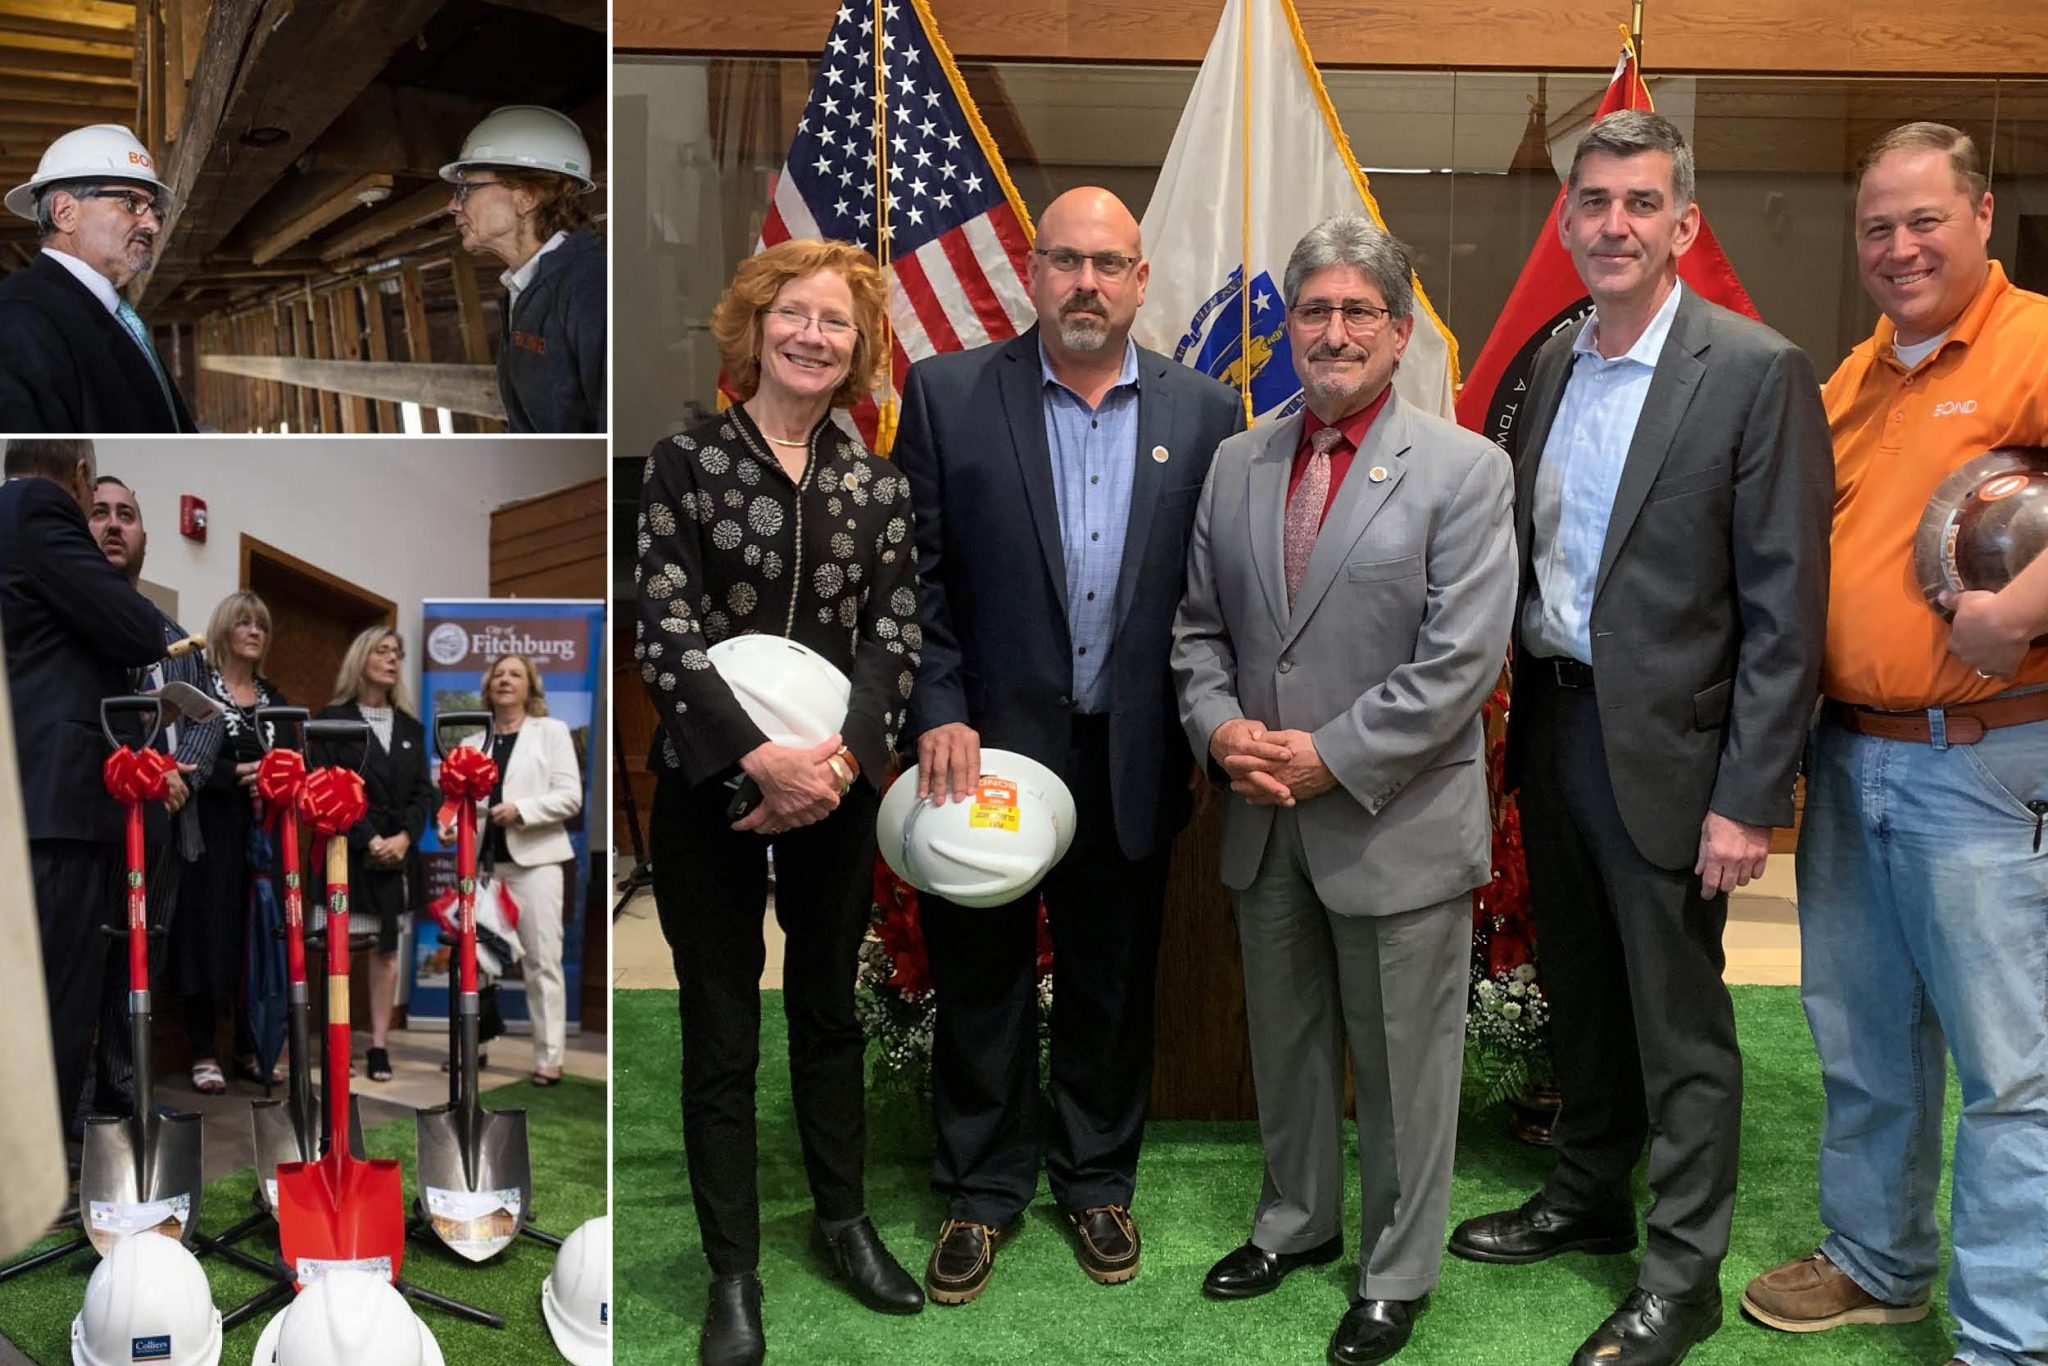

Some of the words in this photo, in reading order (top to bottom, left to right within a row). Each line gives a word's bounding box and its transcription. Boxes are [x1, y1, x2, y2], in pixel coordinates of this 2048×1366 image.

[1513, 377, 1527, 391] A
[1931, 399, 1978, 417] BOND
[471, 633, 576, 661] Fitchburg
[135, 1340, 168, 1351] Colliers
